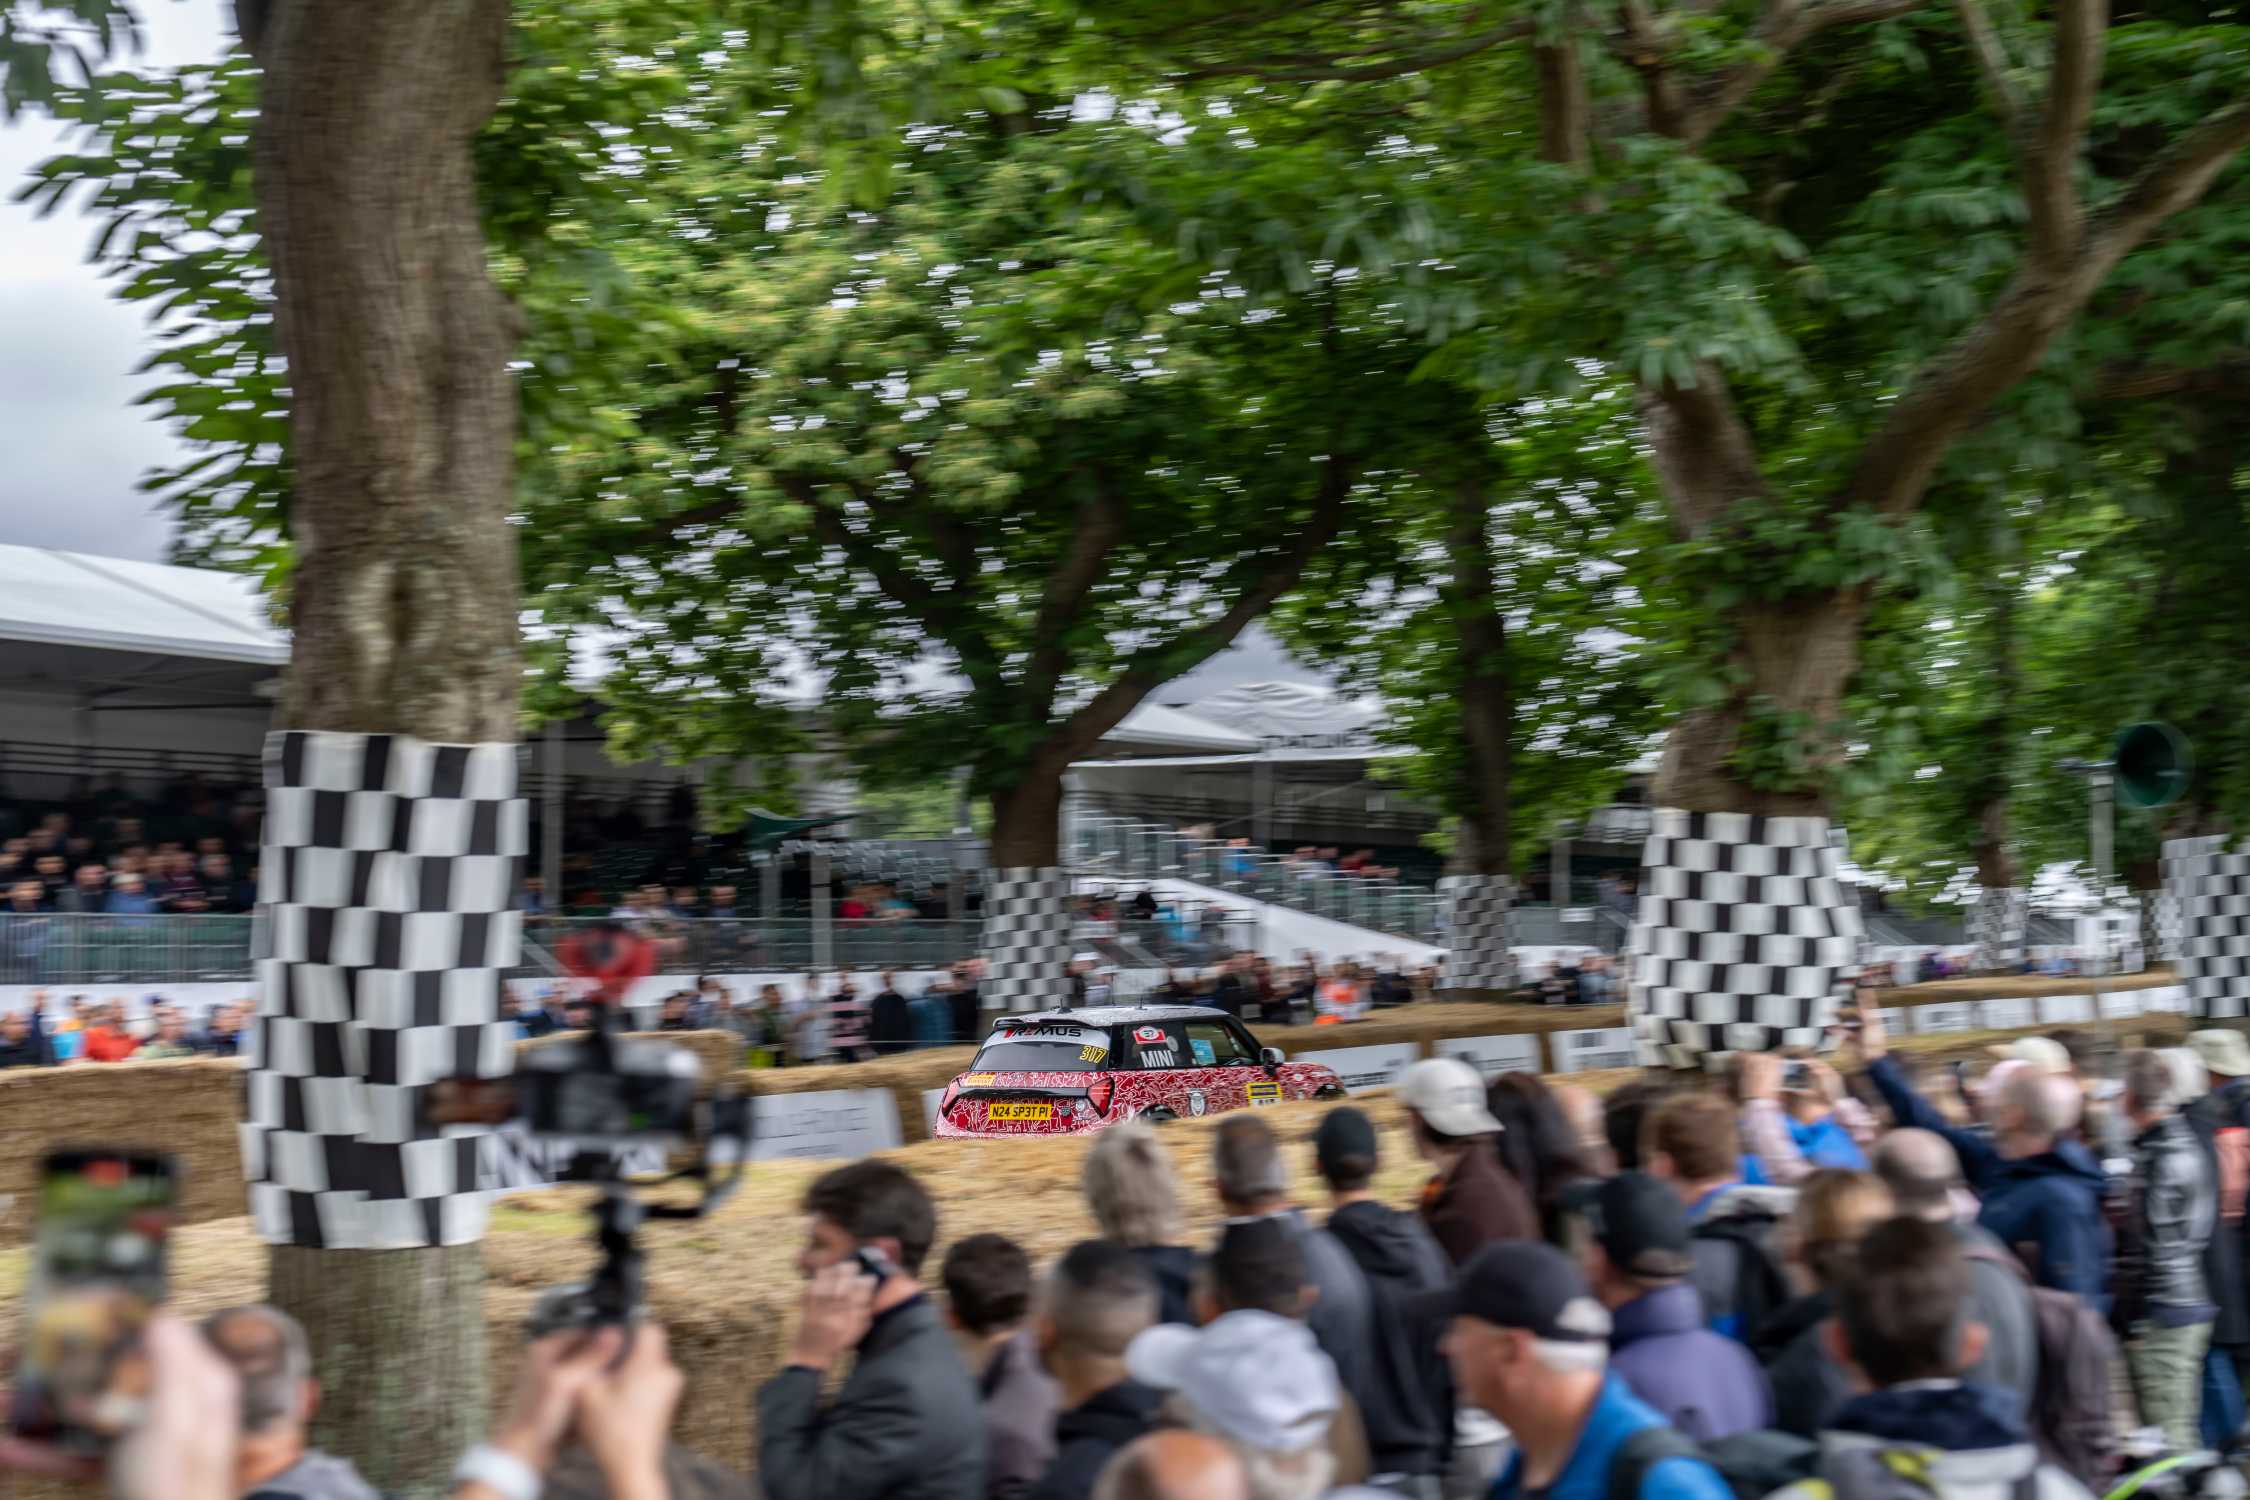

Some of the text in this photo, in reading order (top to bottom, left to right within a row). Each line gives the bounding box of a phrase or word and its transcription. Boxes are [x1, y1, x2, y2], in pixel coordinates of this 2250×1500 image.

[1080, 1045, 1107, 1063] 317
[1140, 1050, 1175, 1068] MINI
[992, 1106, 1010, 1117] N24
